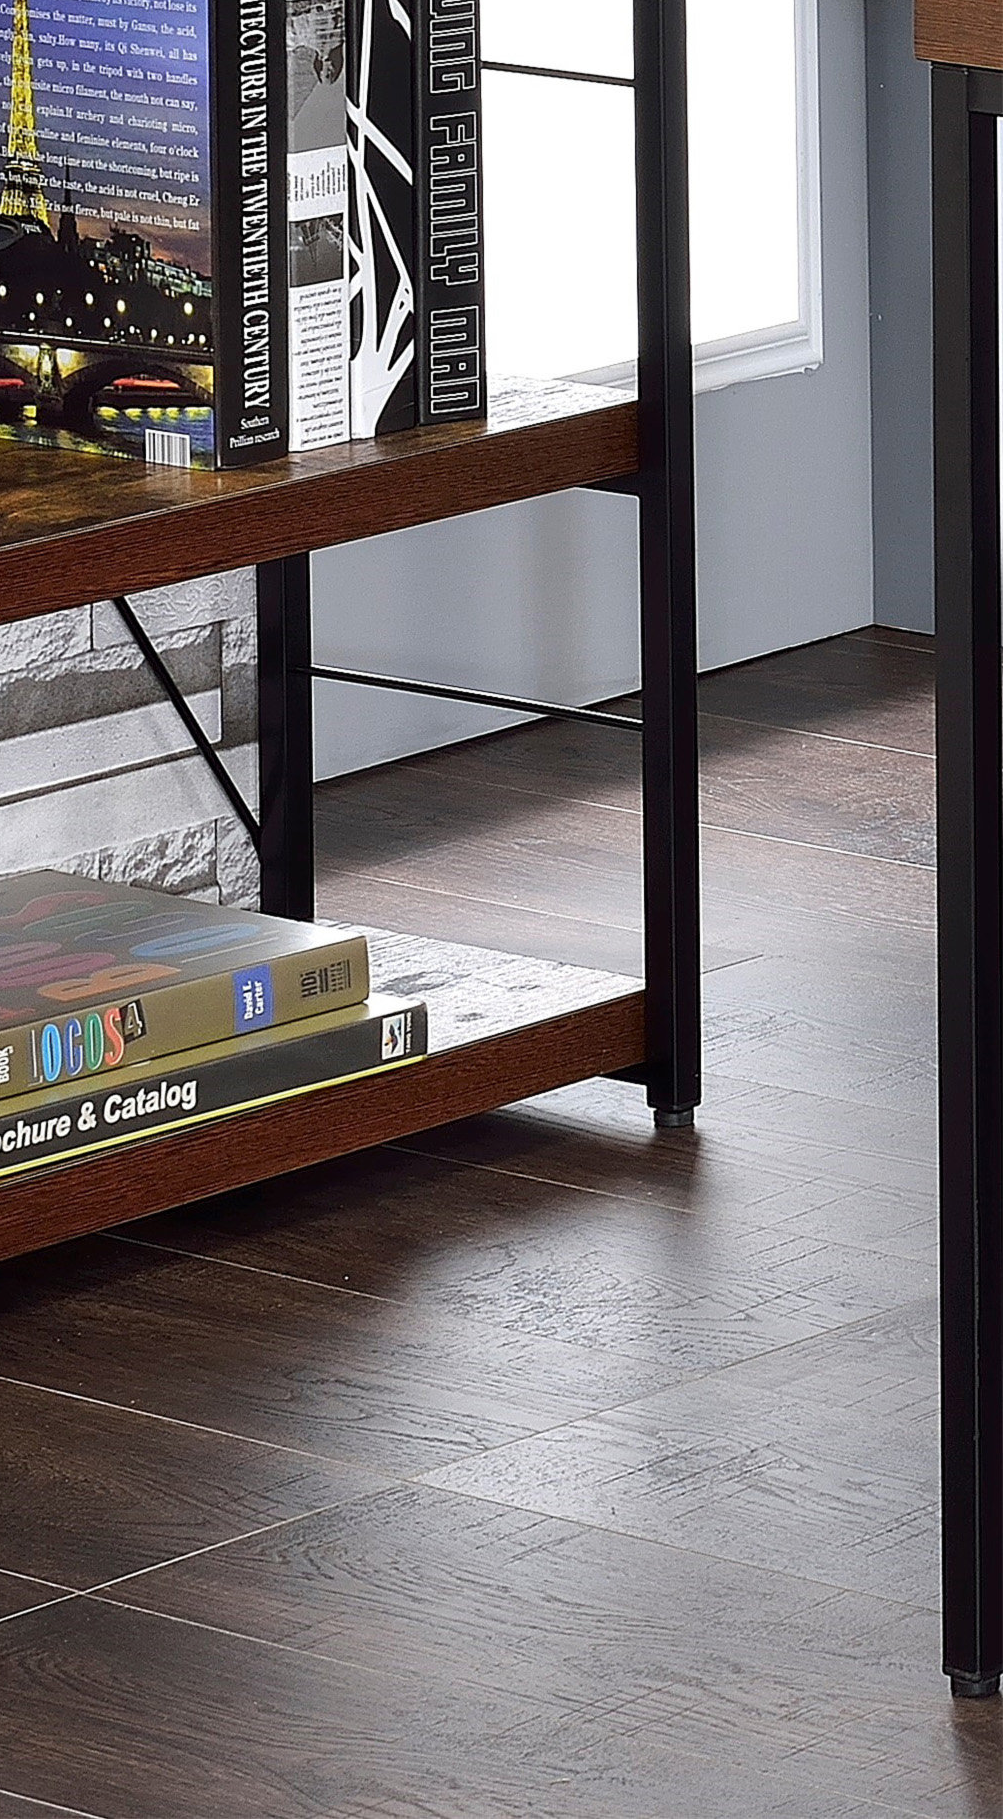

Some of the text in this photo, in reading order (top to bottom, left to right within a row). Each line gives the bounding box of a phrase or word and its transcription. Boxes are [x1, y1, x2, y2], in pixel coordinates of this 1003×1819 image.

[153, 0, 167, 10] not
[168, 0, 185, 12] lose
[185, 1, 197, 13] its
[52, 10, 66, 22] the
[97, 17, 117, 28] must
[118, 17, 129, 32] by
[160, 22, 174, 35] the
[176, 25, 197, 39] acid,
[104, 40, 198, 61] its Qi all has
[37, 57, 54, 69] gets
[56, 61, 69, 72] up,
[71, 60, 81, 71] in
[83, 61, 96, 74] the
[99, 64, 123, 78] tripod
[125, 68, 144, 79] with
[146, 70, 163, 82] two
[165, 71, 198, 86] handles
[52, 81, 75, 94] micro
[110, 88, 123, 101] the
[124, 92, 149, 105] mouth
[150, 96, 164, 107] not
[165, 98, 180, 109] can
[76, 109, 106, 124] archery
[109, 113, 124, 125] and
[127, 115, 168, 133] charioting
[171, 121, 198, 136] micro,
[241, 104, 267, 130] IN
[60, 131, 75, 143] and
[76, 132, 110, 148] feminine
[111, 137, 148, 154] elements,
[149, 142, 167, 155] four
[168, 144, 200, 159] o'clock
[241, 131, 268, 178] THE
[46, 151, 63, 168] long
[63, 155, 81, 168] time
[82, 159, 94, 169] not
[95, 158, 108, 171] the
[159, 167, 173, 180] but
[174, 169, 191, 183] ripe
[191, 170, 200, 183] is
[8, 170, 21, 182] but
[49, 176, 62, 189] the
[63, 179, 84, 193] taste,
[84, 181, 98, 193] the
[98, 184, 115, 196] acid
[116, 185, 124, 197] is
[124, 189, 138, 200] not
[139, 190, 161, 203] cruel,
[162, 191, 188, 208] Cheng
[189, 195, 201, 207] Er
[53, 200, 61, 211] is
[62, 203, 74, 213] not
[100, 207, 113, 219] but
[114, 209, 131, 223] pale
[131, 211, 139, 223] is
[140, 214, 153, 225] not
[153, 214, 173, 229] thin,
[173, 217, 187, 230] but
[187, 219, 200, 231] fat
[242, 178, 269, 308] TWENTIETH
[243, 310, 270, 409] CENTURY
[243, 992, 254, 1021] David
[254, 980, 264, 1015] Carter
[26, 1001, 144, 1088] LOGOS 4
[77, 1101, 98, 1131] &
[103, 1079, 198, 1124] Catalog
